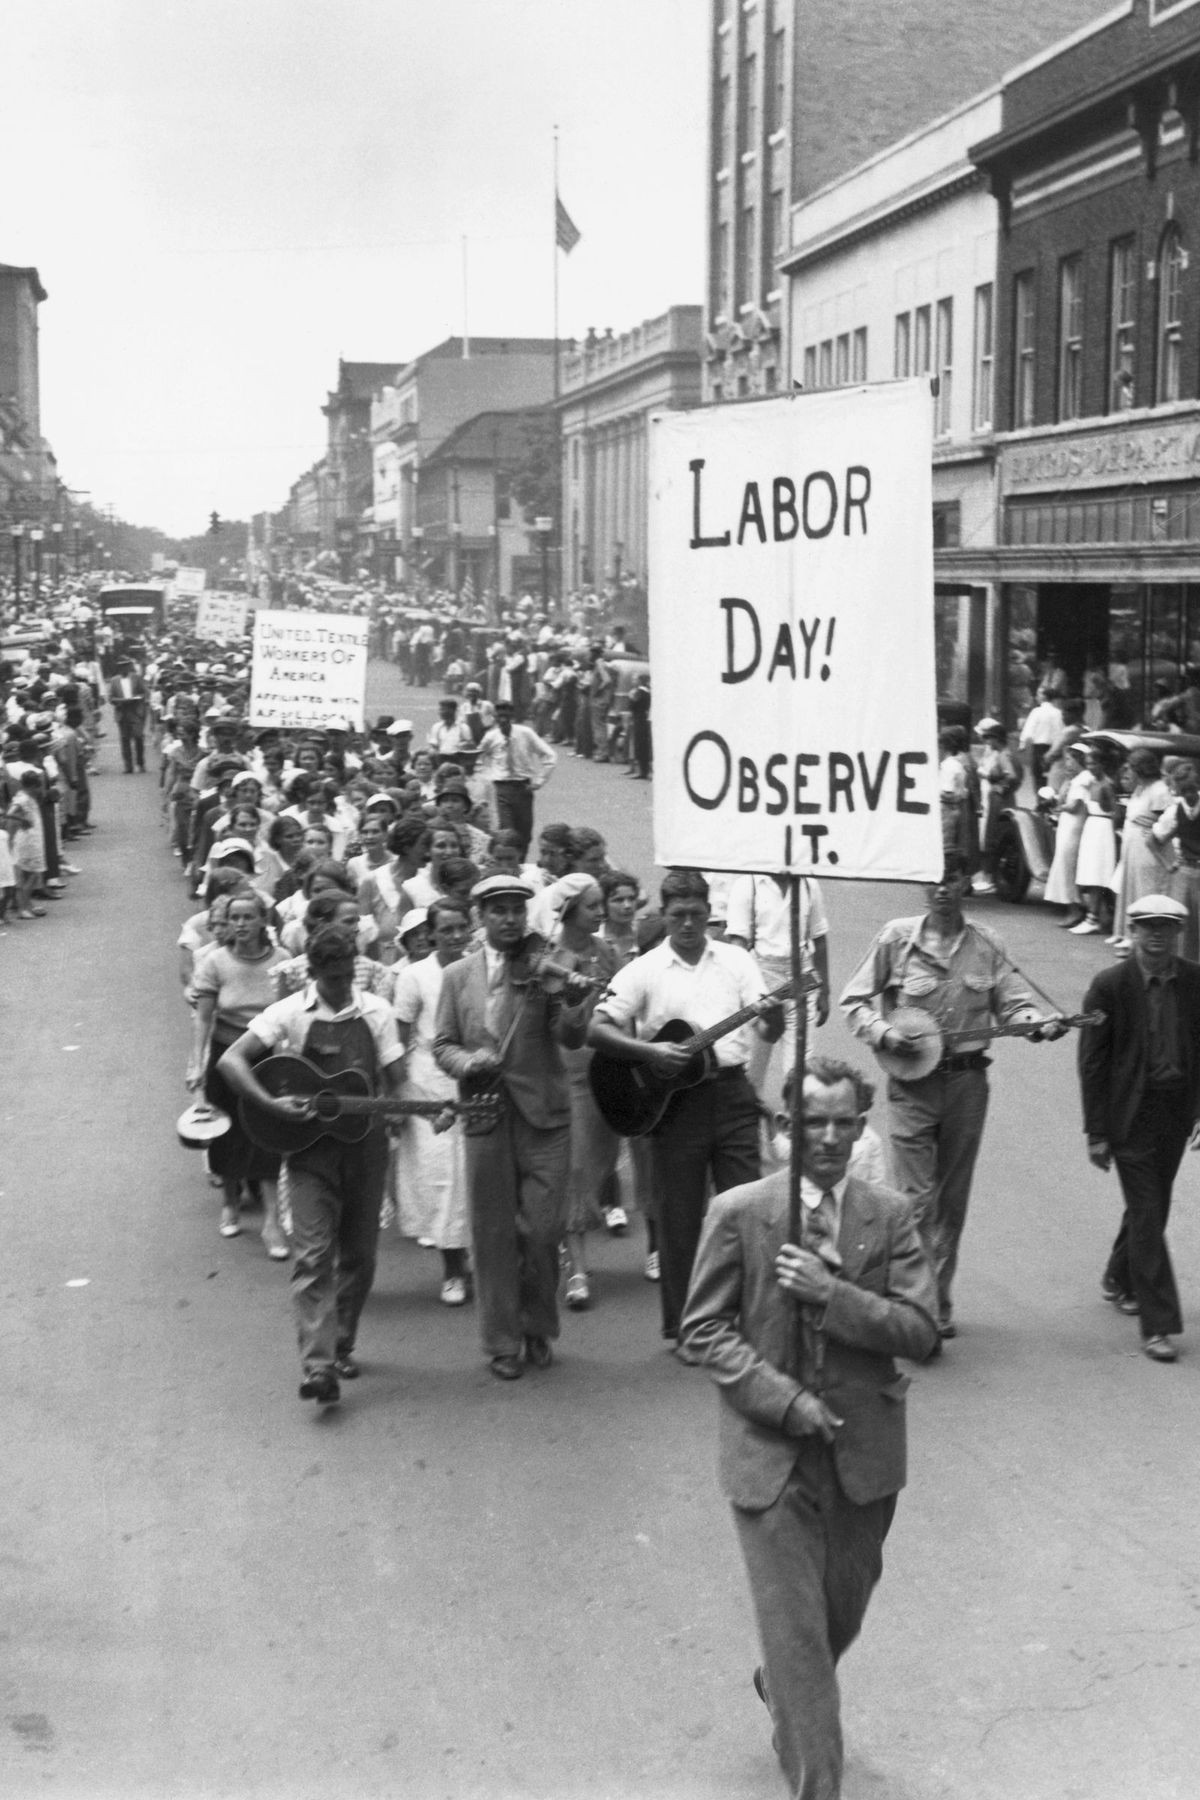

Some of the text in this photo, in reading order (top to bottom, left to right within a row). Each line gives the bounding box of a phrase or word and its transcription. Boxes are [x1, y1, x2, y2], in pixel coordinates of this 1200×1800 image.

[690, 458, 871, 548] LABOR
[260, 645, 356, 664] WORKERS OF
[316, 628, 368, 646] TEXTILE
[720, 598, 836, 684] DAY!
[269, 666, 325, 682] AMERICA
[683, 729, 930, 815] OBSERVE
[785, 824, 839, 866] IT.
